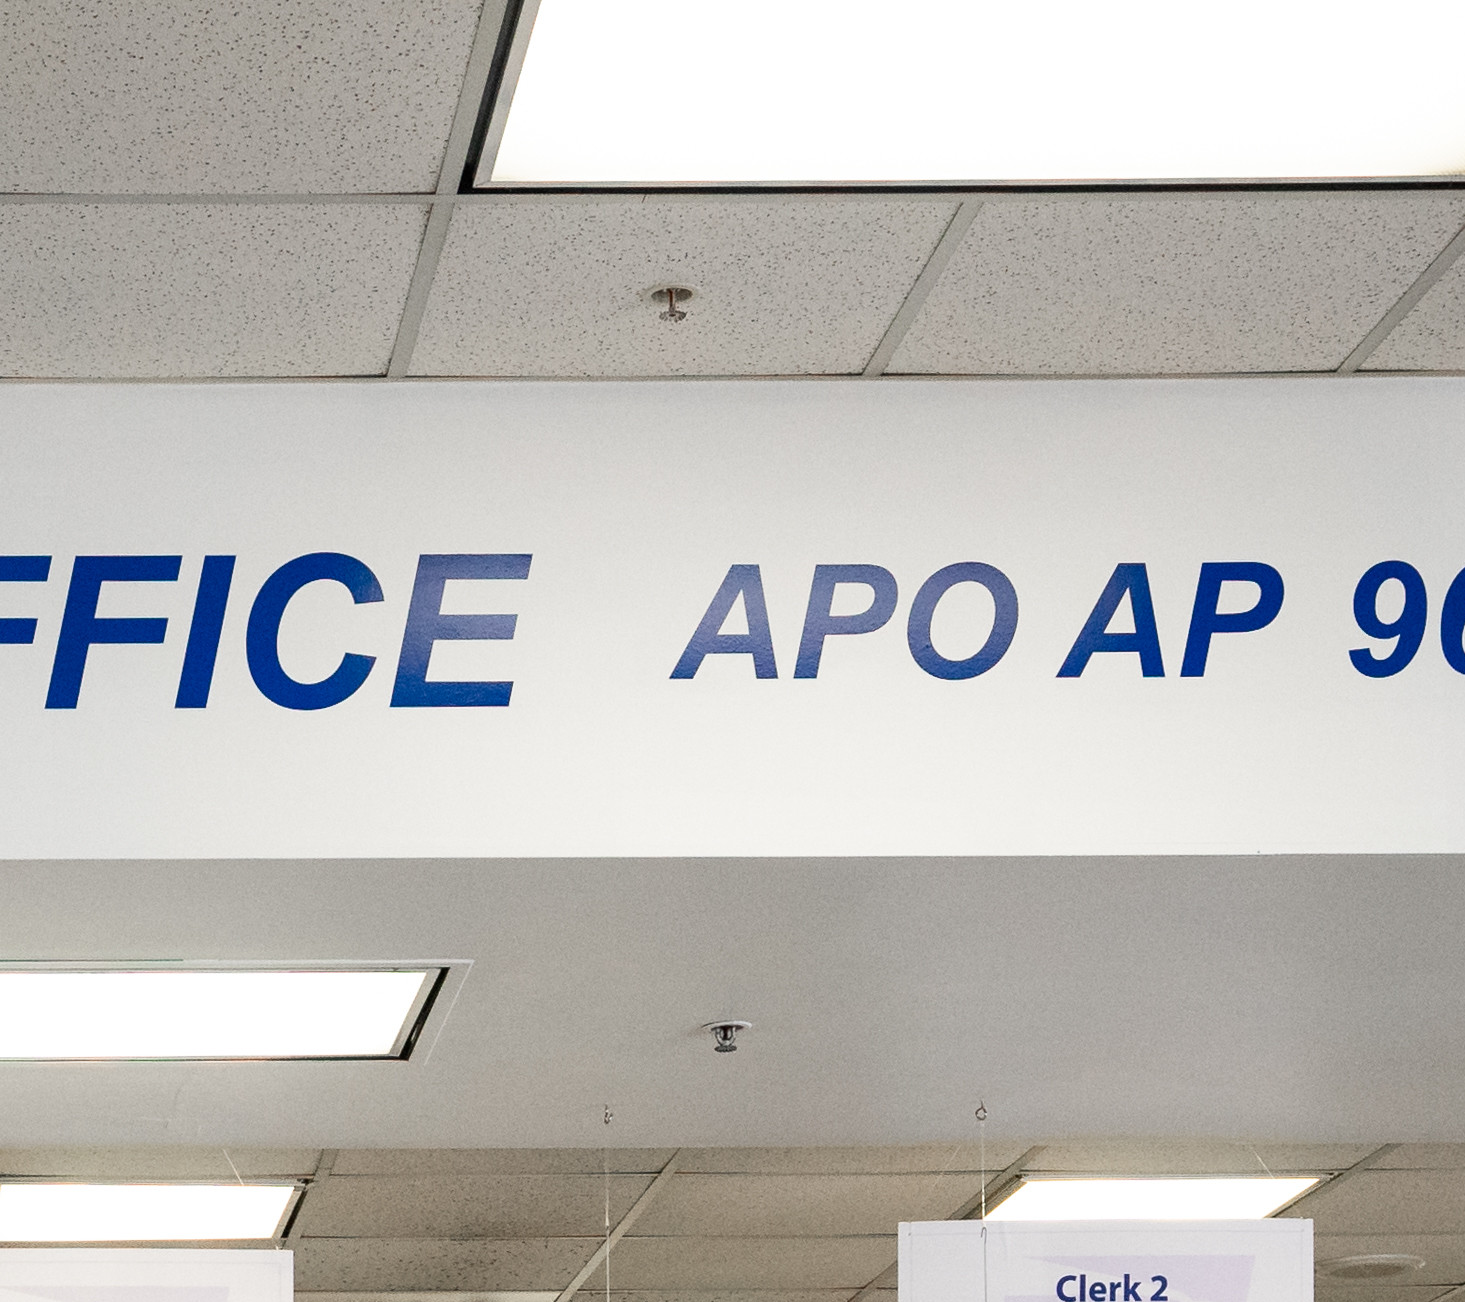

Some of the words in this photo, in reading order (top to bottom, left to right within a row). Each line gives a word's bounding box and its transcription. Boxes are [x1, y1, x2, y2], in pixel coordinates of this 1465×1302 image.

[669, 561, 1019, 681] APO
[1056, 561, 1285, 678] AP
[1056, 1273, 1142, 1302] Clerk
[1150, 1275, 1169, 1302] 2
